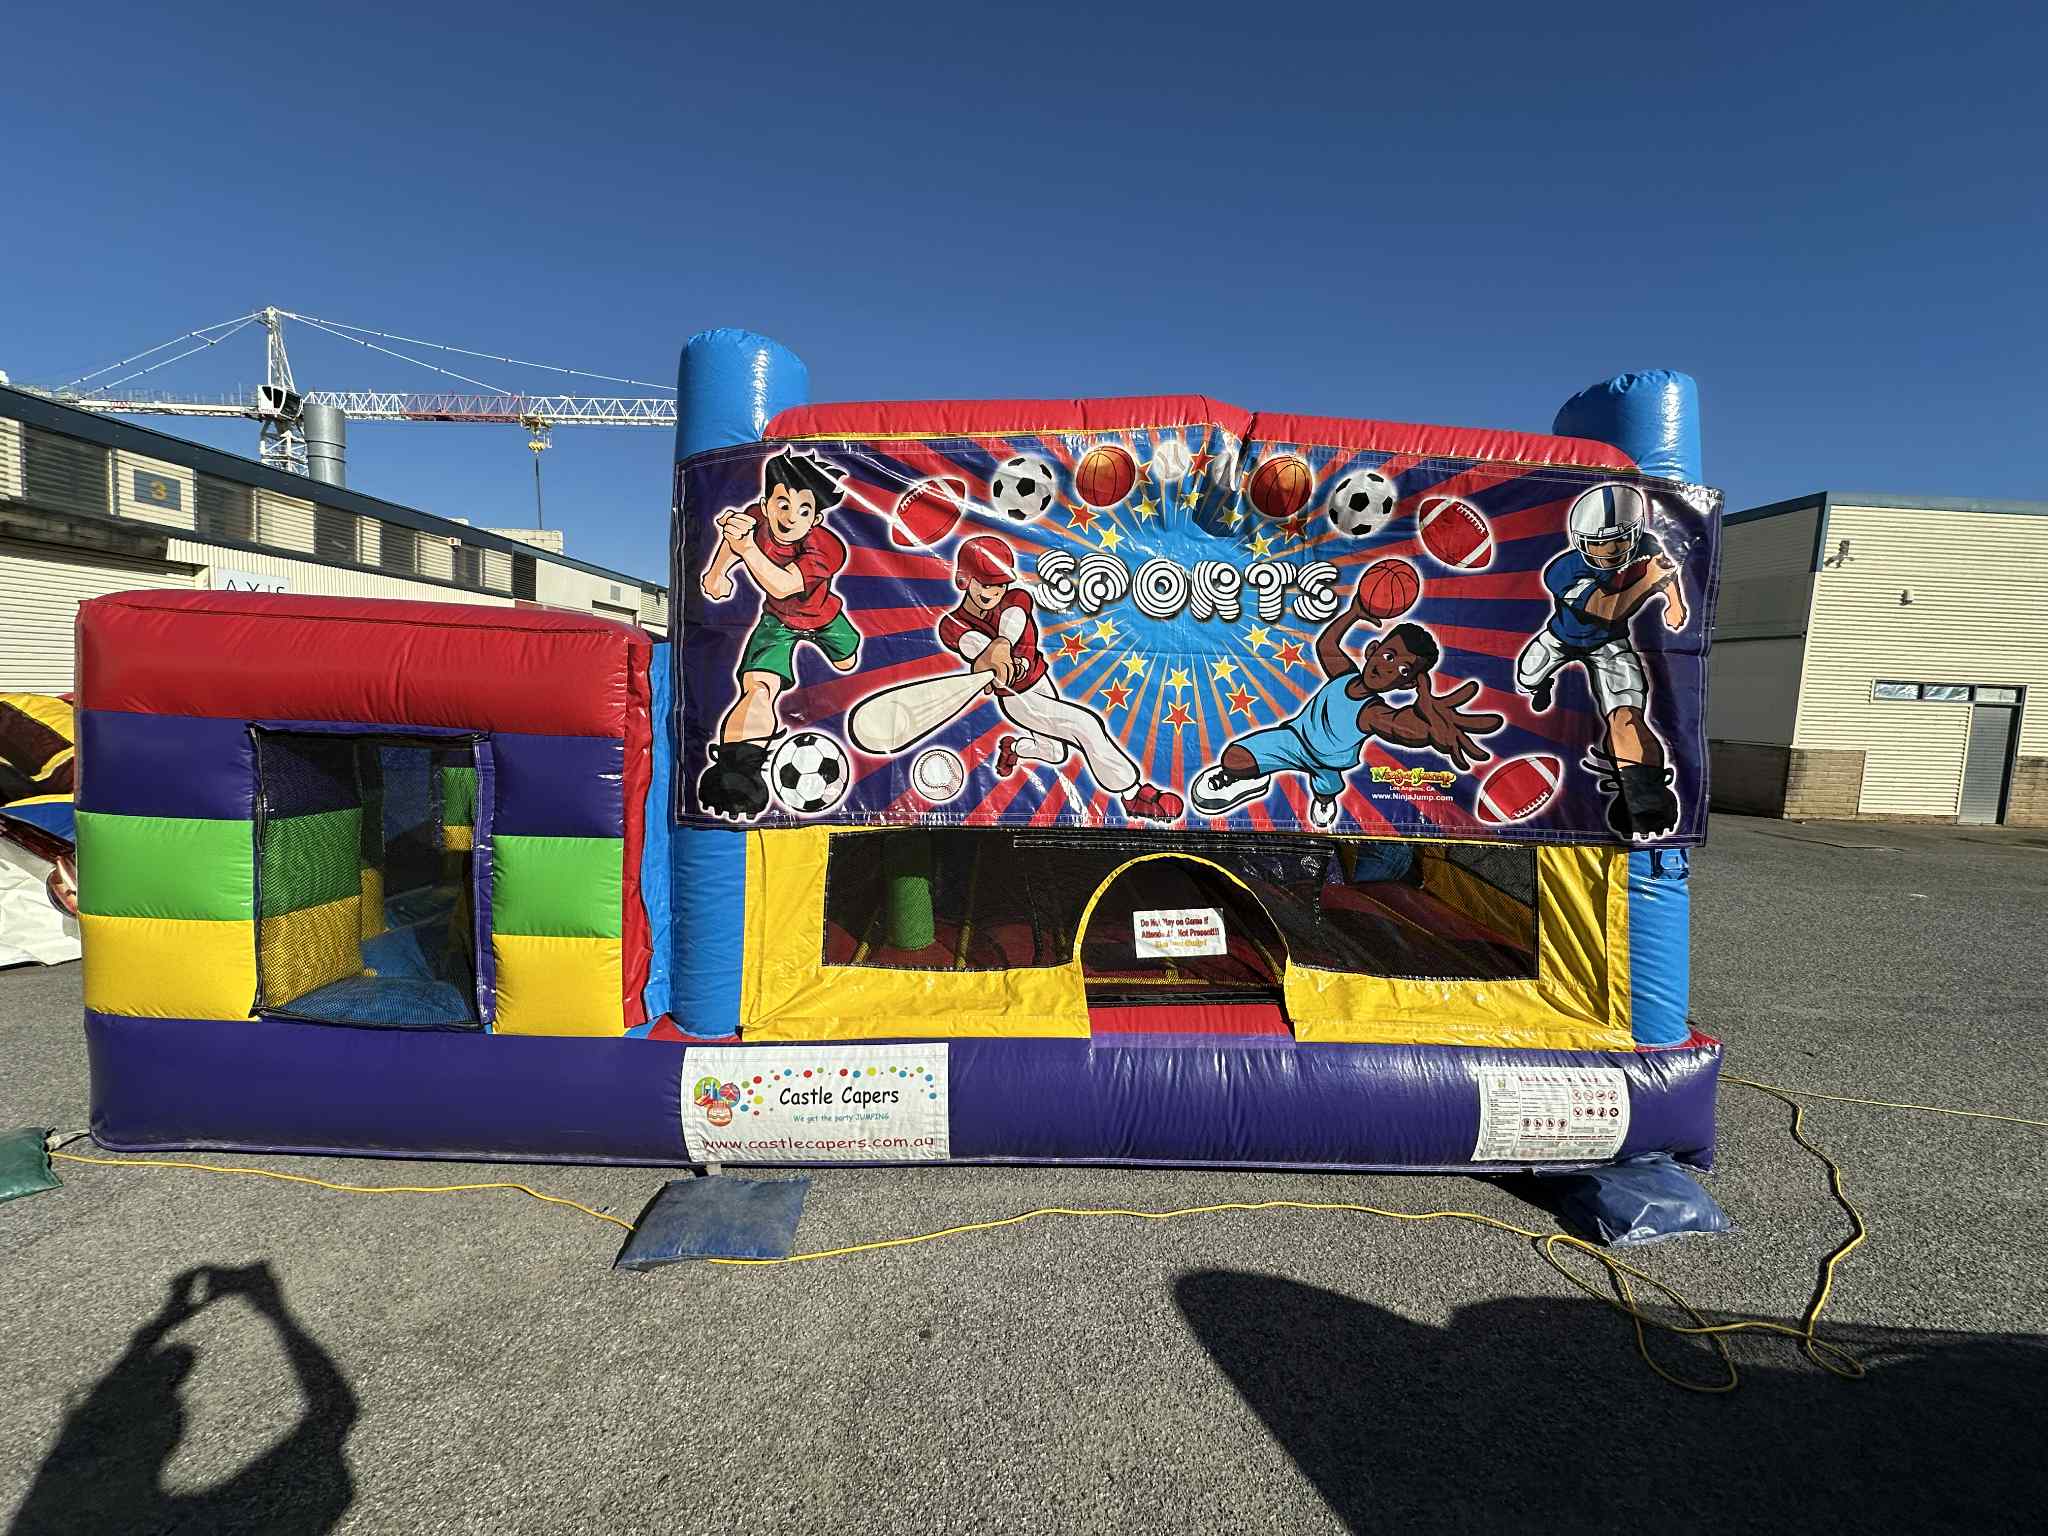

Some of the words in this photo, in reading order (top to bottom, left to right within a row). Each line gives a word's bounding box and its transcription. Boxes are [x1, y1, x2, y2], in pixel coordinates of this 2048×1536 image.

[152, 480, 168, 500] 3
[1032, 549, 1338, 621] SPORTS
[1371, 792, 1454, 802] www.NinjaJump.com
[1140, 919, 1150, 928] Do
[1185, 917, 1203, 925] Game
[779, 1085, 833, 1105] Castle
[841, 1086, 899, 1109] Capers
[793, 1113, 804, 1122] We
[807, 1114, 818, 1124] get
[821, 1113, 832, 1121] the
[834, 1113, 853, 1123] party
[854, 1112, 890, 1121] JUMPING
[702, 1136, 934, 1151] www.castlecapers.com.au
